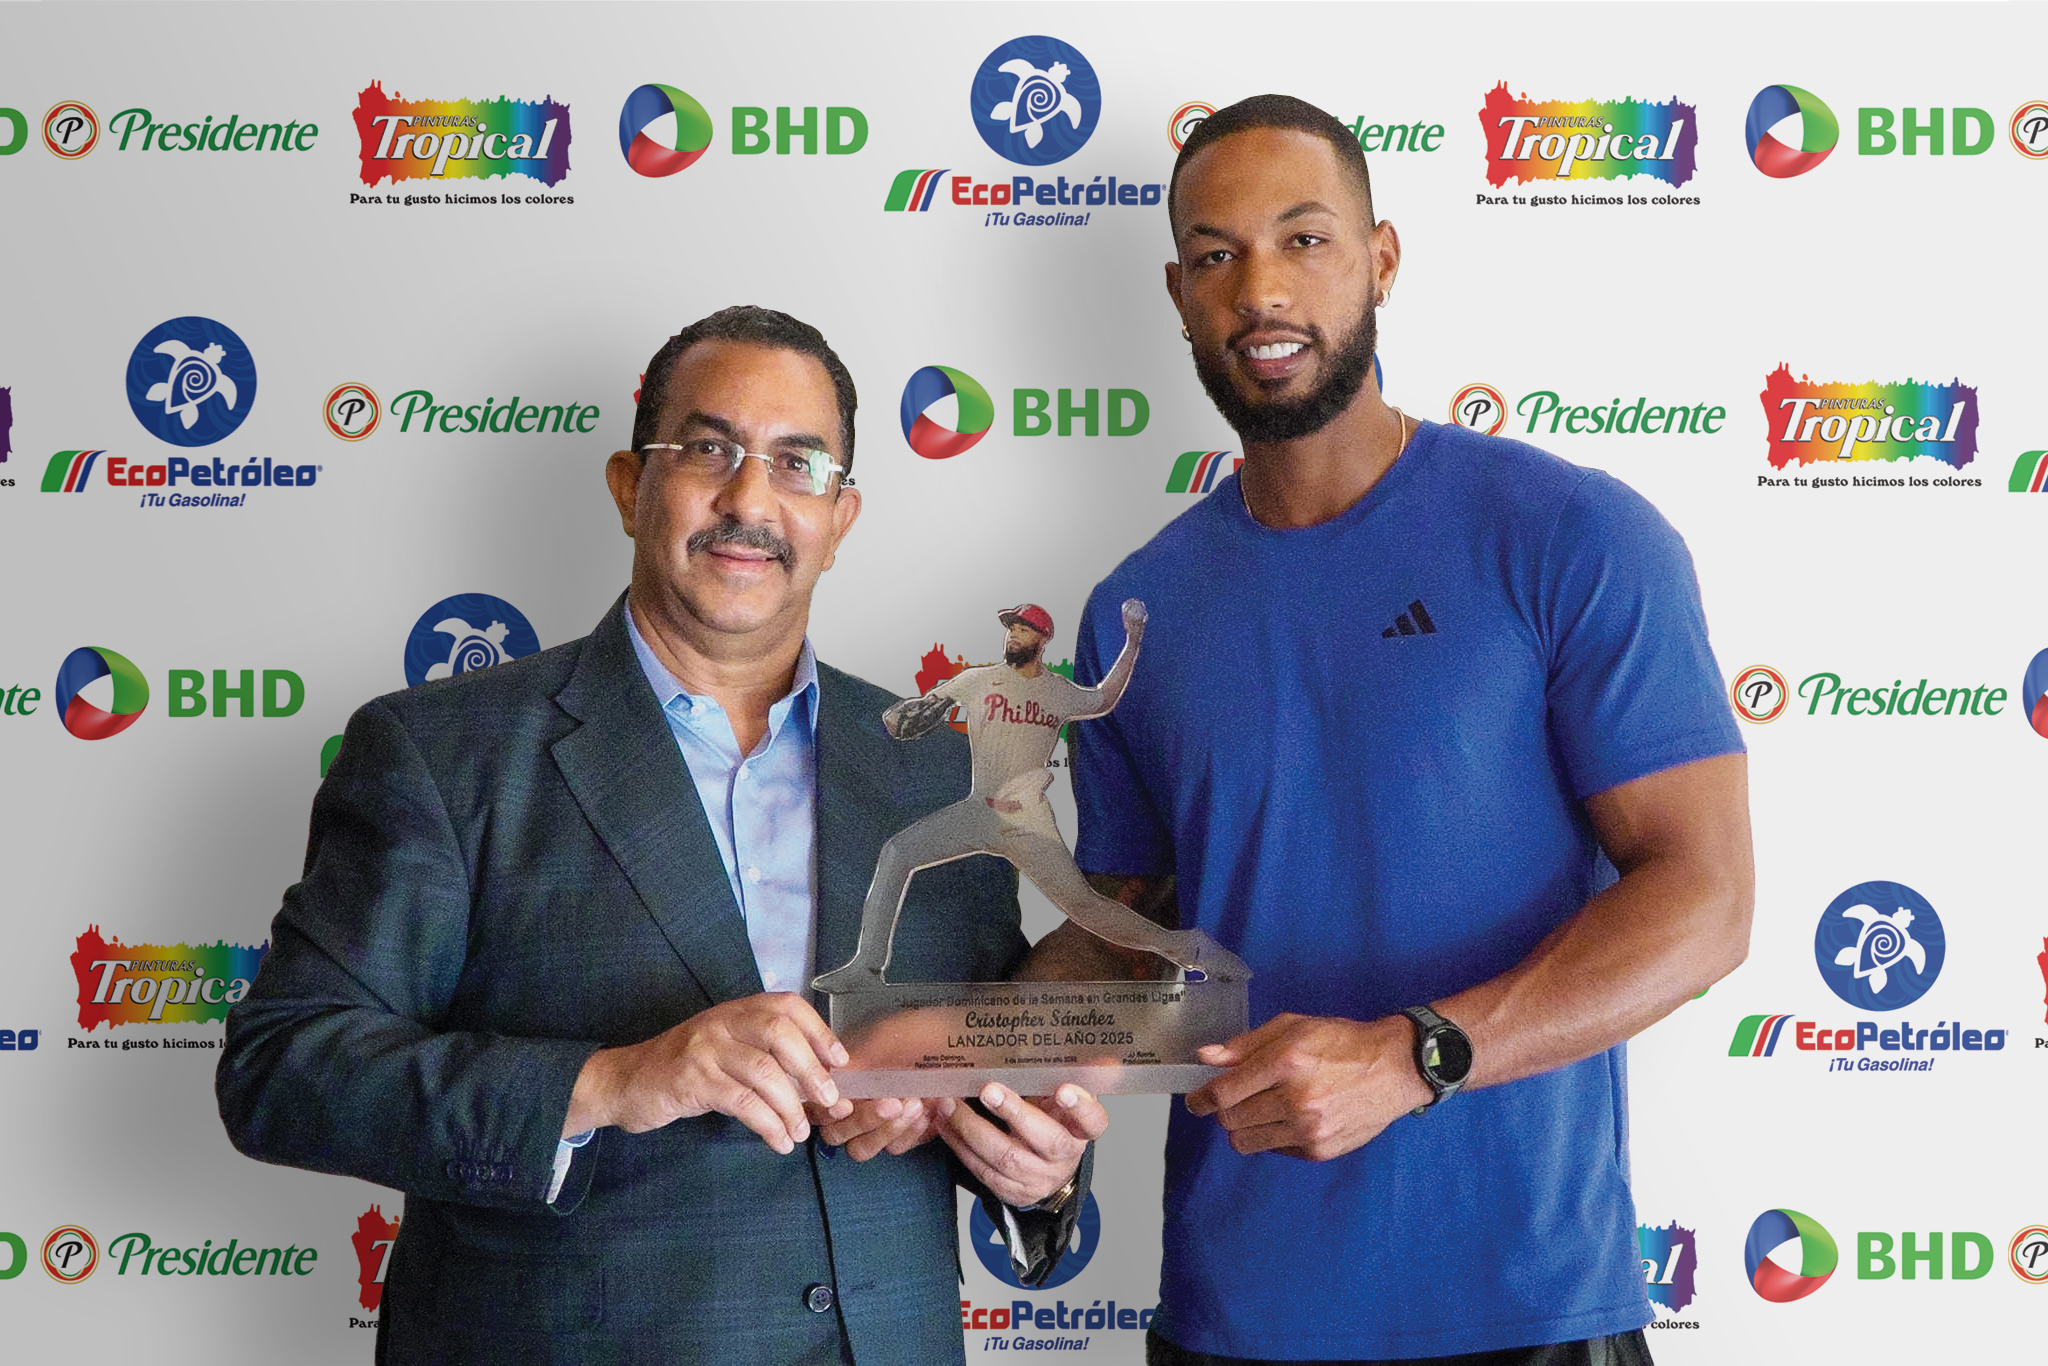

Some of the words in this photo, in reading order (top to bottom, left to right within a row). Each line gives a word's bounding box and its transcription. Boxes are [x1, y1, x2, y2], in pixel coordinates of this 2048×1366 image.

[109, 108, 319, 152] Presidente
[412, 115, 479, 127] PINTURAS
[732, 107, 869, 155] BHD
[1538, 116, 1605, 128] PINTURAS
[1858, 108, 1995, 156] BHD
[371, 115, 559, 176] Tropical
[1497, 116, 1685, 177] Tropical
[350, 193, 382, 204] Para
[386, 193, 400, 204] tu
[404, 193, 441, 206] gusto
[444, 193, 498, 204] hicimos
[501, 193, 521, 204] los
[525, 193, 574, 204] colores
[1476, 194, 1508, 205] Para
[1512, 194, 1526, 205] tu
[1530, 194, 1567, 207] gusto
[1570, 194, 1624, 205] hicimos
[1627, 194, 1647, 205] los
[1651, 194, 1700, 205] colores
[985, 212, 1010, 227] ¡Tu
[1013, 212, 1090, 226] Gasolina!
[390, 390, 600, 434] Presidente
[1013, 389, 1150, 437] BHD
[1517, 390, 1727, 434] Presidente
[1820, 398, 1887, 410] PINTURAS
[1779, 398, 1967, 459] Tropical
[1758, 476, 1790, 487] Para
[1794, 476, 1808, 487] tu
[1812, 476, 1849, 489] gusto
[1852, 476, 1906, 487] hicimos
[1909, 476, 1929, 487] los
[1933, 476, 1982, 487] colores
[140, 493, 165, 508] ¡Tu
[168, 493, 245, 507] Gasolina!
[168, 670, 305, 718] BHD
[1798, 672, 2008, 716] Presidente
[984, 693, 1059, 728] Phillies
[130, 960, 197, 972] PINTURAS
[89, 960, 250, 1021] Tropica
[1103, 992, 1148, 1004] Grandes
[965, 1010, 1045, 1032] Cristopher
[1050, 1009, 1115, 1027] Sánchez
[68, 1038, 100, 1049] Para
[104, 1038, 118, 1049] tu
[122, 1038, 159, 1051] gusto
[162, 1038, 216, 1049] hicimos
[947, 1033, 1028, 1048] LANZADOR
[1033, 1033, 1061, 1046] DEL
[1064, 1030, 1096, 1045] AÑO
[1100, 1031, 1134, 1045] 2025
[1829, 1057, 1854, 1072] ¡Tu
[1857, 1057, 1934, 1071] Gasolina!
[108, 1232, 318, 1276] Presidente
[1857, 1232, 1994, 1280] BHD
[1651, 1318, 1700, 1329] colores
[984, 1336, 1009, 1351] ¡Tu
[1012, 1336, 1089, 1350] Gasolina!
